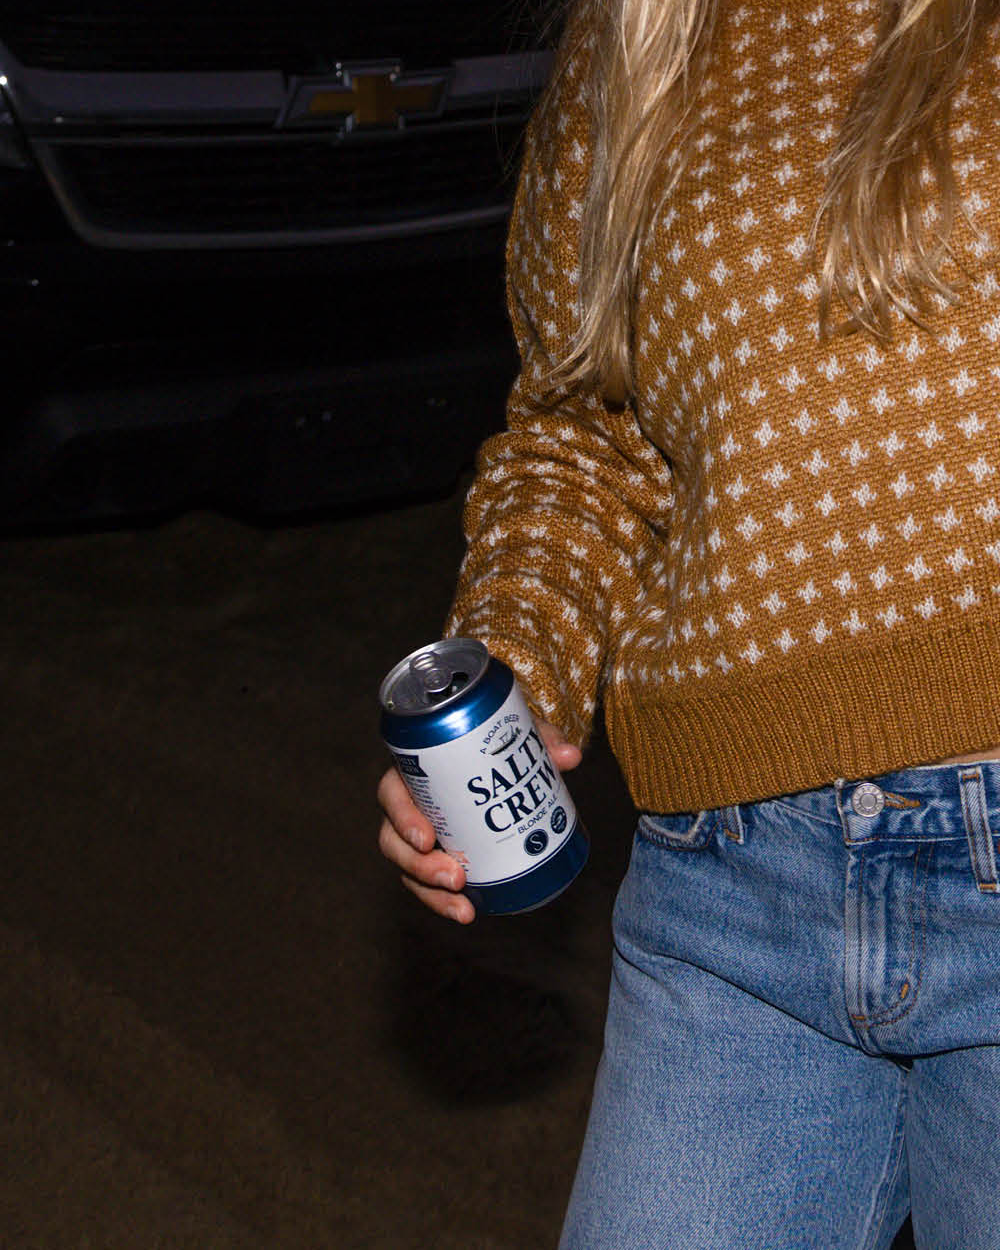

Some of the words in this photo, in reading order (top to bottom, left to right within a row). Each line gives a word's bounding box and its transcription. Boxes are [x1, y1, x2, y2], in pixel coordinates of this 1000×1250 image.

[483, 720, 503, 744] BOAT
[503, 714, 520, 724] BEER
[467, 727, 544, 806] SALTY
[485, 752, 556, 832] CREW
[517, 806, 548, 834] BLONDE
